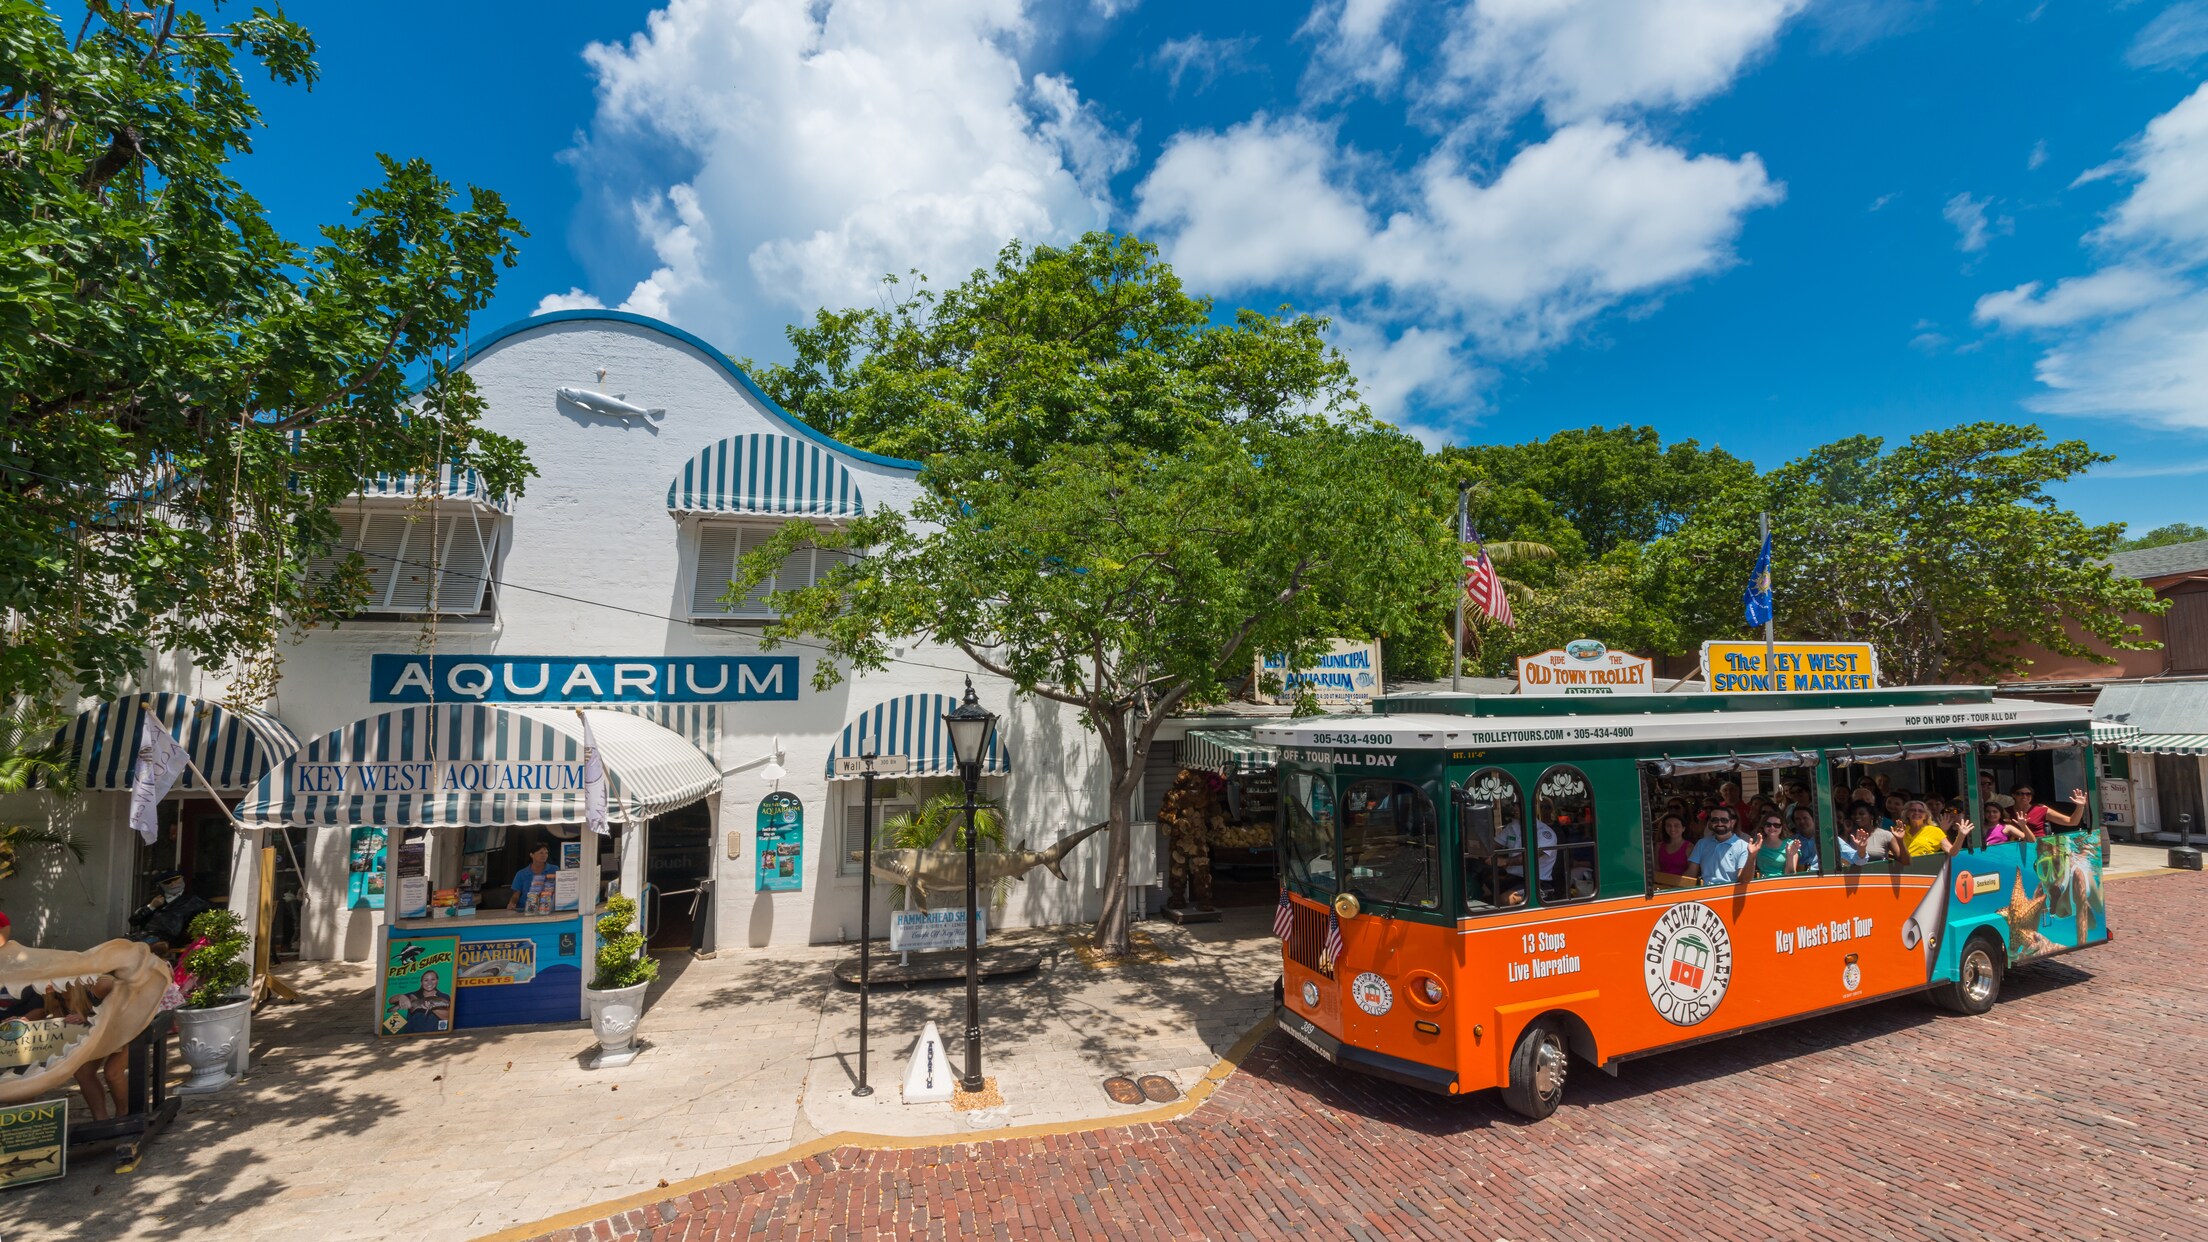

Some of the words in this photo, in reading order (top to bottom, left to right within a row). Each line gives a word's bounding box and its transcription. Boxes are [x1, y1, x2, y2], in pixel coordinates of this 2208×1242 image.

[1550, 655, 1565, 666] RIDE
[1608, 655, 1623, 665] THE
[1725, 652, 1761, 671] The
[1807, 653, 1858, 671] WEST
[389, 662, 784, 699] AQUARIUM
[1284, 672, 1355, 692] AQUARIUM
[1525, 662, 1552, 685] OLD
[1553, 668, 1588, 685] TOWN
[1588, 663, 1646, 685] TROLLEY
[1794, 674, 1870, 691] MARKET
[1905, 716, 1921, 725] HOP
[1922, 716, 1934, 725] ON
[1935, 715, 1951, 724] HOP
[1952, 714, 1965, 723] OFF
[1971, 713, 1989, 722] TOUR
[1991, 712, 2003, 721] ALL
[2004, 712, 2018, 720] DAY
[1313, 733, 1393, 744] 305-434-4900
[1472, 729, 1564, 743] TROLLEYTOURS.COM
[1574, 727, 1634, 739] 305-434-4900
[843, 761, 861, 771] Wall
[865, 760, 875, 771] St
[1283, 750, 1299, 761] OFF
[1305, 751, 1331, 763] TOUR
[1333, 753, 1361, 765] ALL
[1365, 754, 1397, 766] DAY
[298, 765, 351, 791] KEY
[356, 764, 432, 791] WEST
[442, 764, 585, 791] AQUARIUM
[1961, 880, 1968, 899] 1
[897, 911, 955, 926] HAMMERHEAD
[955, 910, 982, 922] SHK
[1522, 933, 1536, 954] 13
[1538, 932, 1566, 953] Stops
[1775, 930, 1794, 955] Key
[1796, 923, 1828, 949] West's
[1830, 919, 1852, 943] Best
[1853, 916, 1873, 939] Tour
[486, 942, 519, 950] WEST
[1646, 929, 1667, 964] OLD
[1661, 904, 1701, 933] TOWN
[1701, 909, 1731, 989] TROLLEY
[388, 964, 410, 977] PET
[409, 963, 417, 973] A
[419, 952, 453, 970] SHARK
[459, 948, 531, 967] QUARIUM
[1508, 962, 1530, 983] Live
[1532, 954, 1581, 979] Narration
[457, 976, 512, 986] TICKETS
[1650, 976, 1711, 1024] TOURS
[26, 1021, 68, 1032] WEST
[1300, 1021, 1315, 1034] 389
